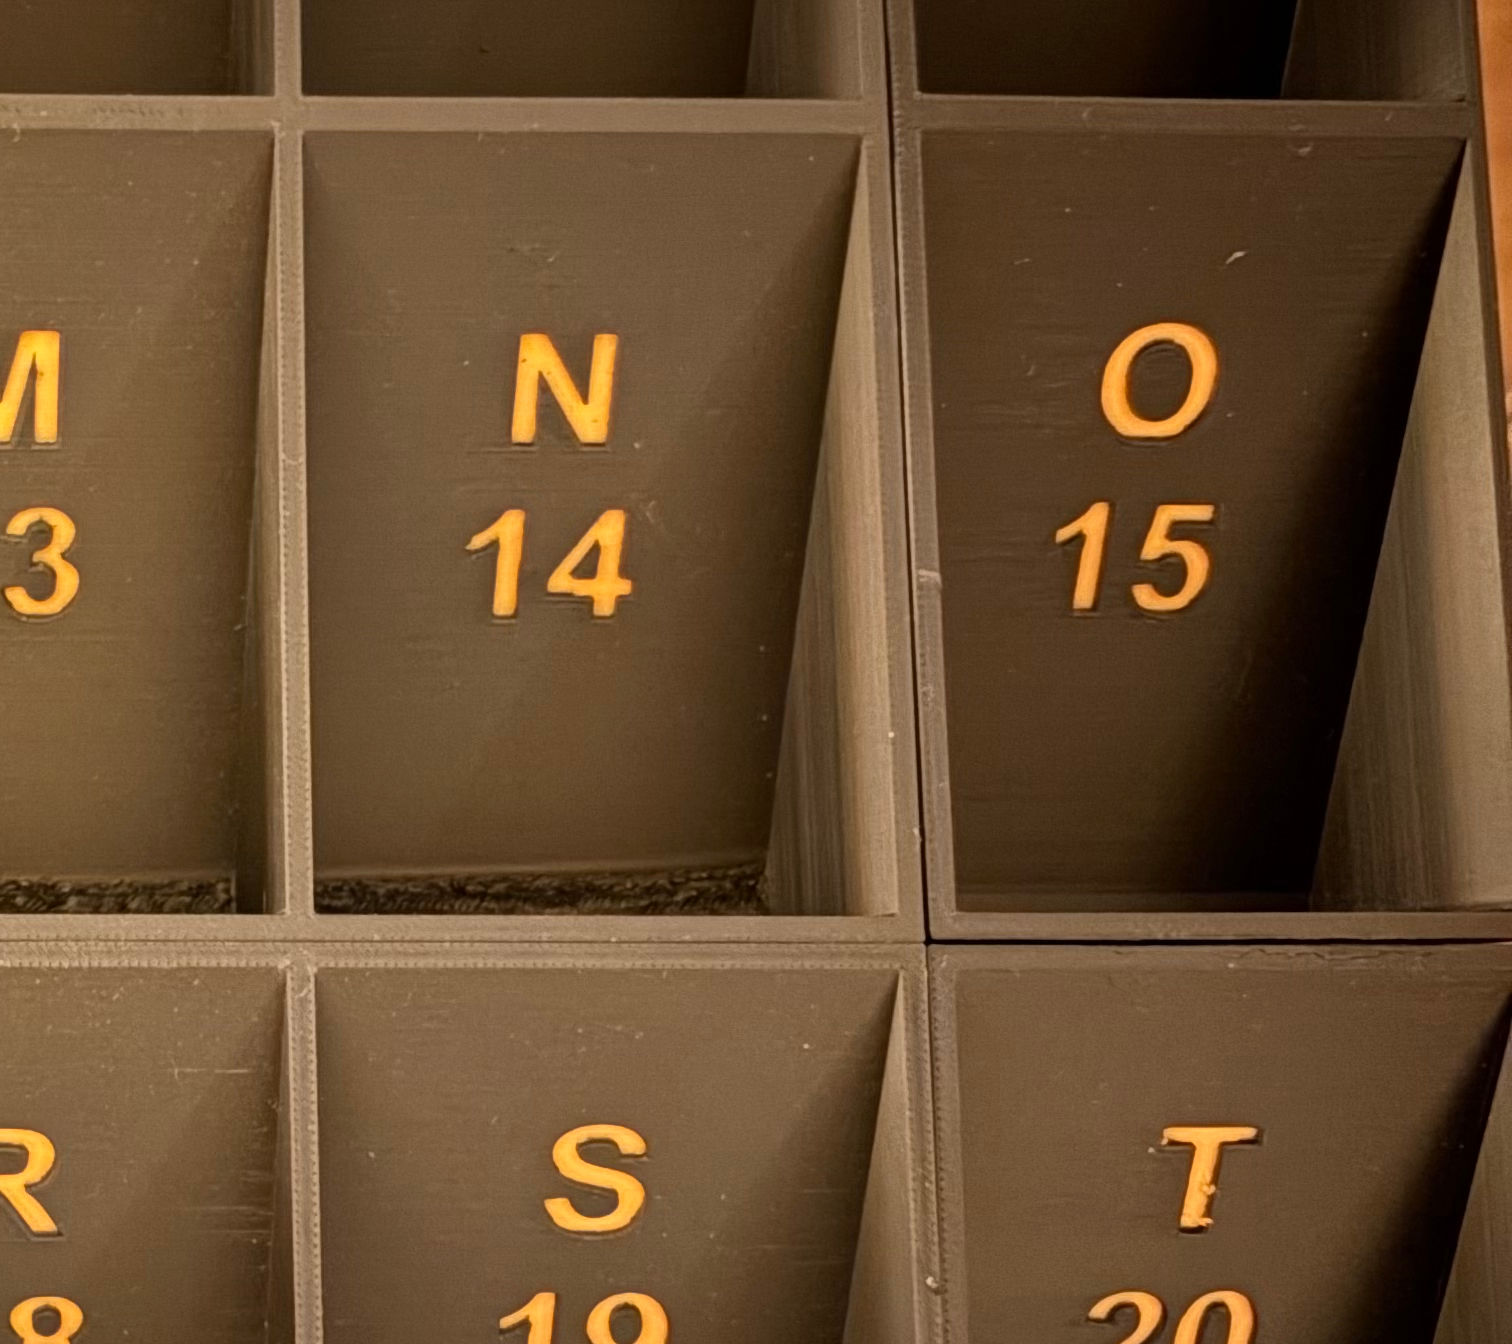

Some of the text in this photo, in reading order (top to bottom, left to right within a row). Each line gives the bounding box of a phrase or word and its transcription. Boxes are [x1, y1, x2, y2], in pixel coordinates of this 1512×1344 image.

[510, 328, 620, 447] N
[1100, 320, 1221, 439] O
[465, 505, 635, 618] 14
[1055, 501, 1215, 612] 15
[543, 1123, 651, 1235] S
[1156, 1125, 1258, 1231] T
